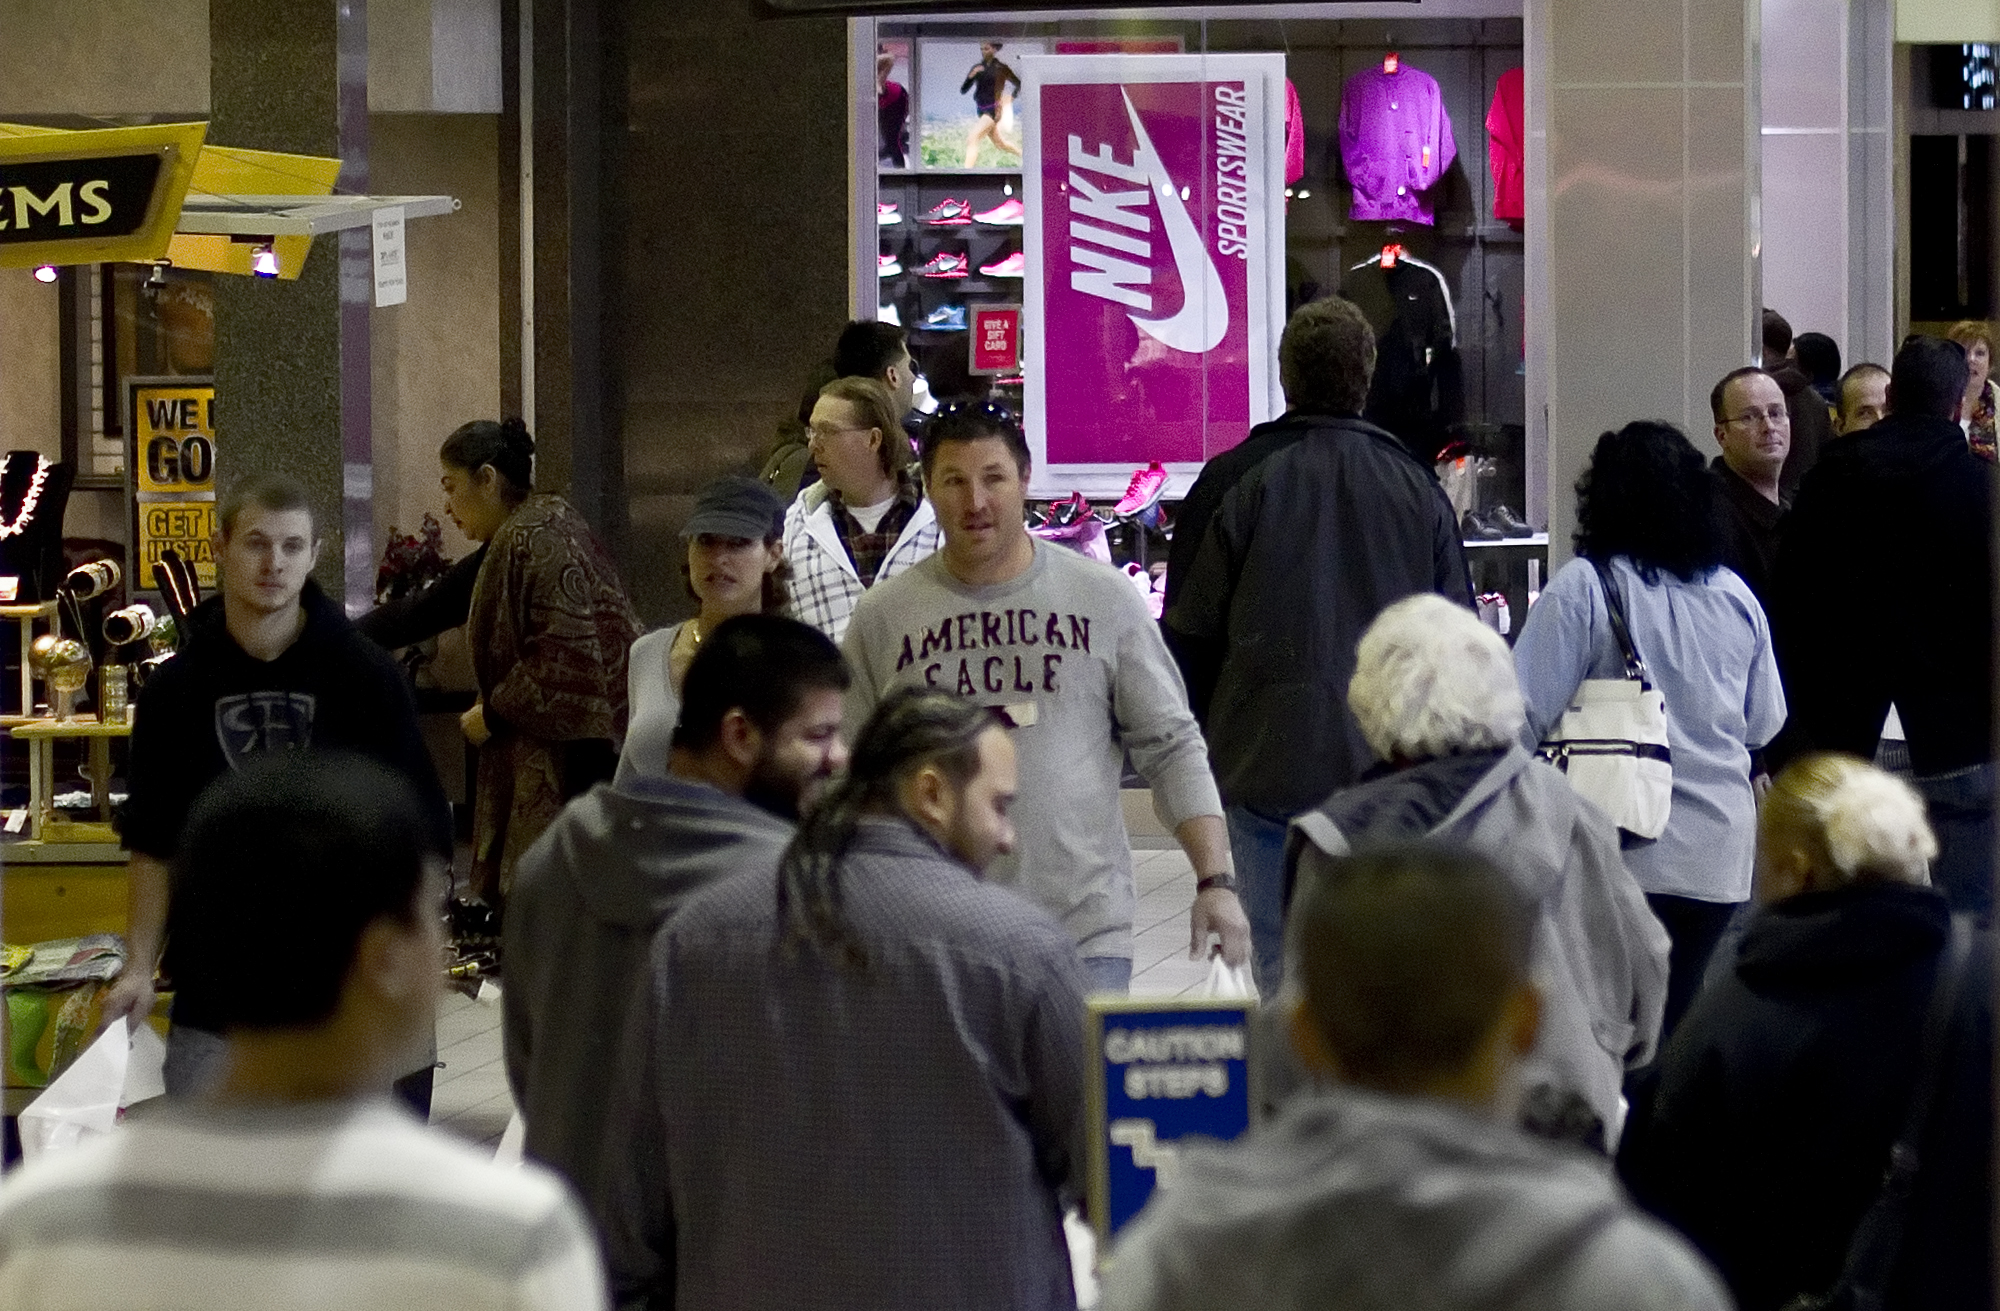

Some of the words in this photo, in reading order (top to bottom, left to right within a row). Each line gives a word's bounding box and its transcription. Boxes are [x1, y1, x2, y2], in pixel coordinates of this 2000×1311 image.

[1215, 86, 1248, 260] SPORTSWEAR
[1068, 133, 1153, 311] NIKE
[146, 399, 199, 431] WE
[147, 508, 202, 538] GET
[896, 609, 1091, 672] AMERICAN
[925, 654, 1062, 696] EAGLE
[1105, 1027, 1245, 1064] CAUTION
[1124, 1064, 1229, 1100] STEPS
